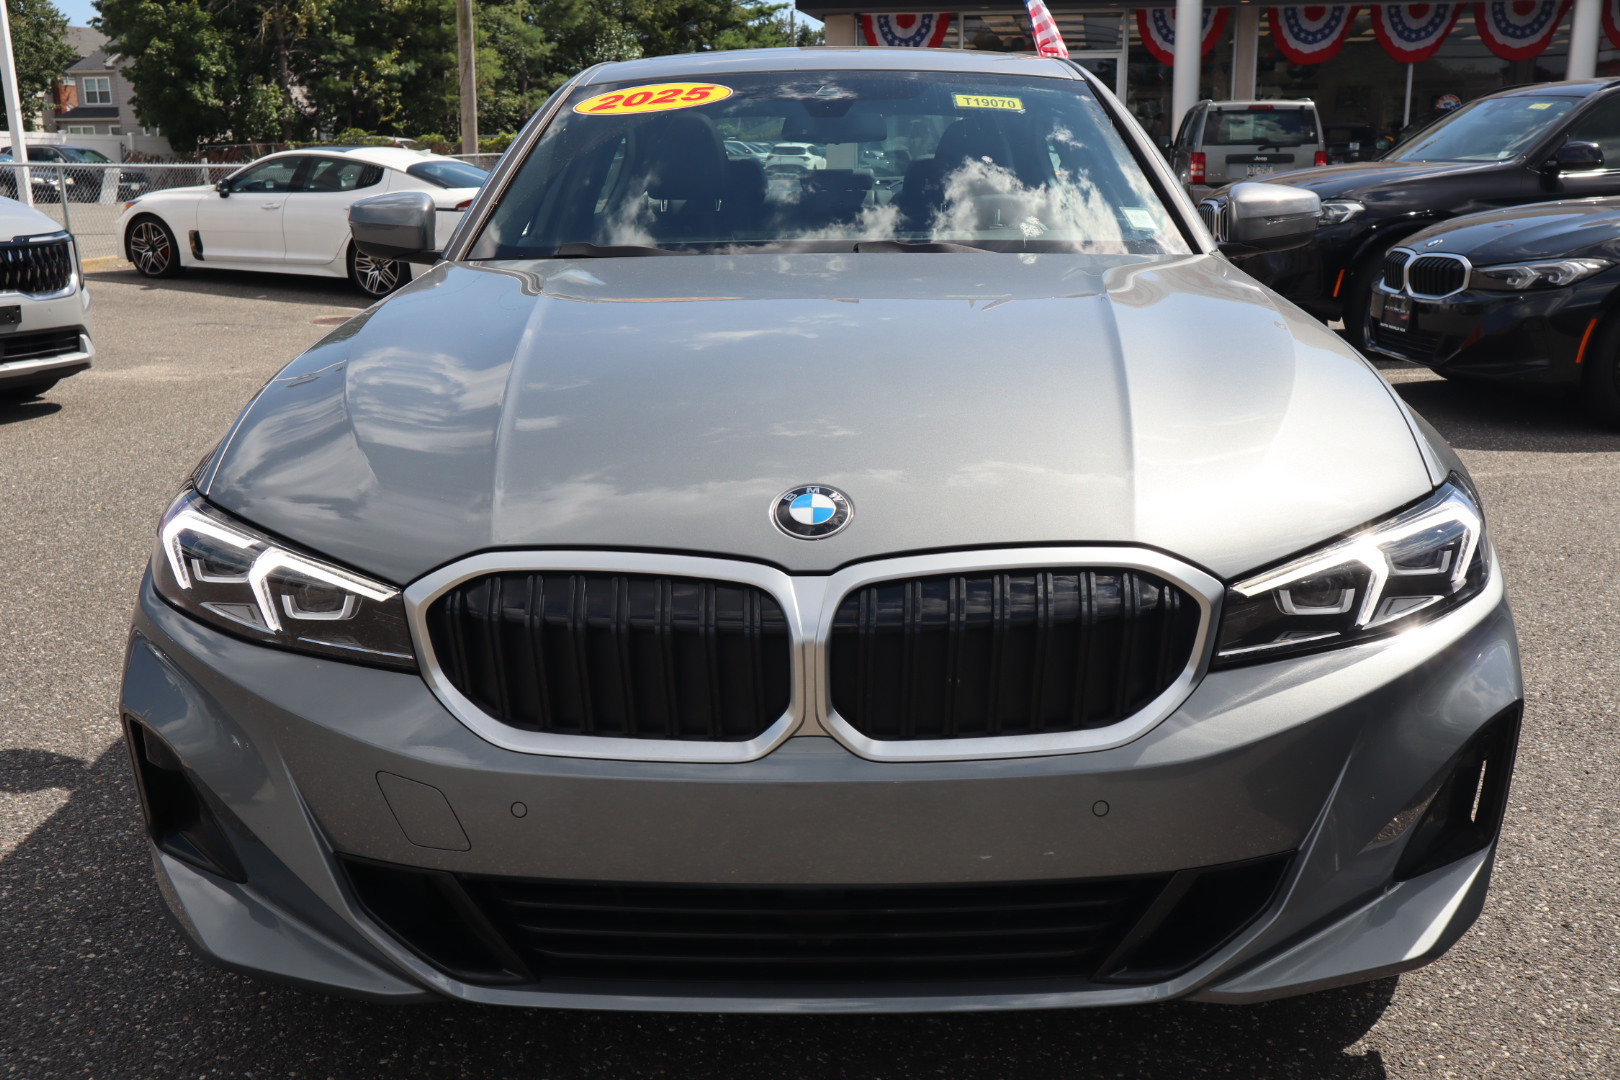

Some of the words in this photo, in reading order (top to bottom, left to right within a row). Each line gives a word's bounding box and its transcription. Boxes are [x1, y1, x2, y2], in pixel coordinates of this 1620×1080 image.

[588, 86, 716, 112] 2025
[963, 97, 1016, 109] T19070
[783, 487, 844, 502] BMW
